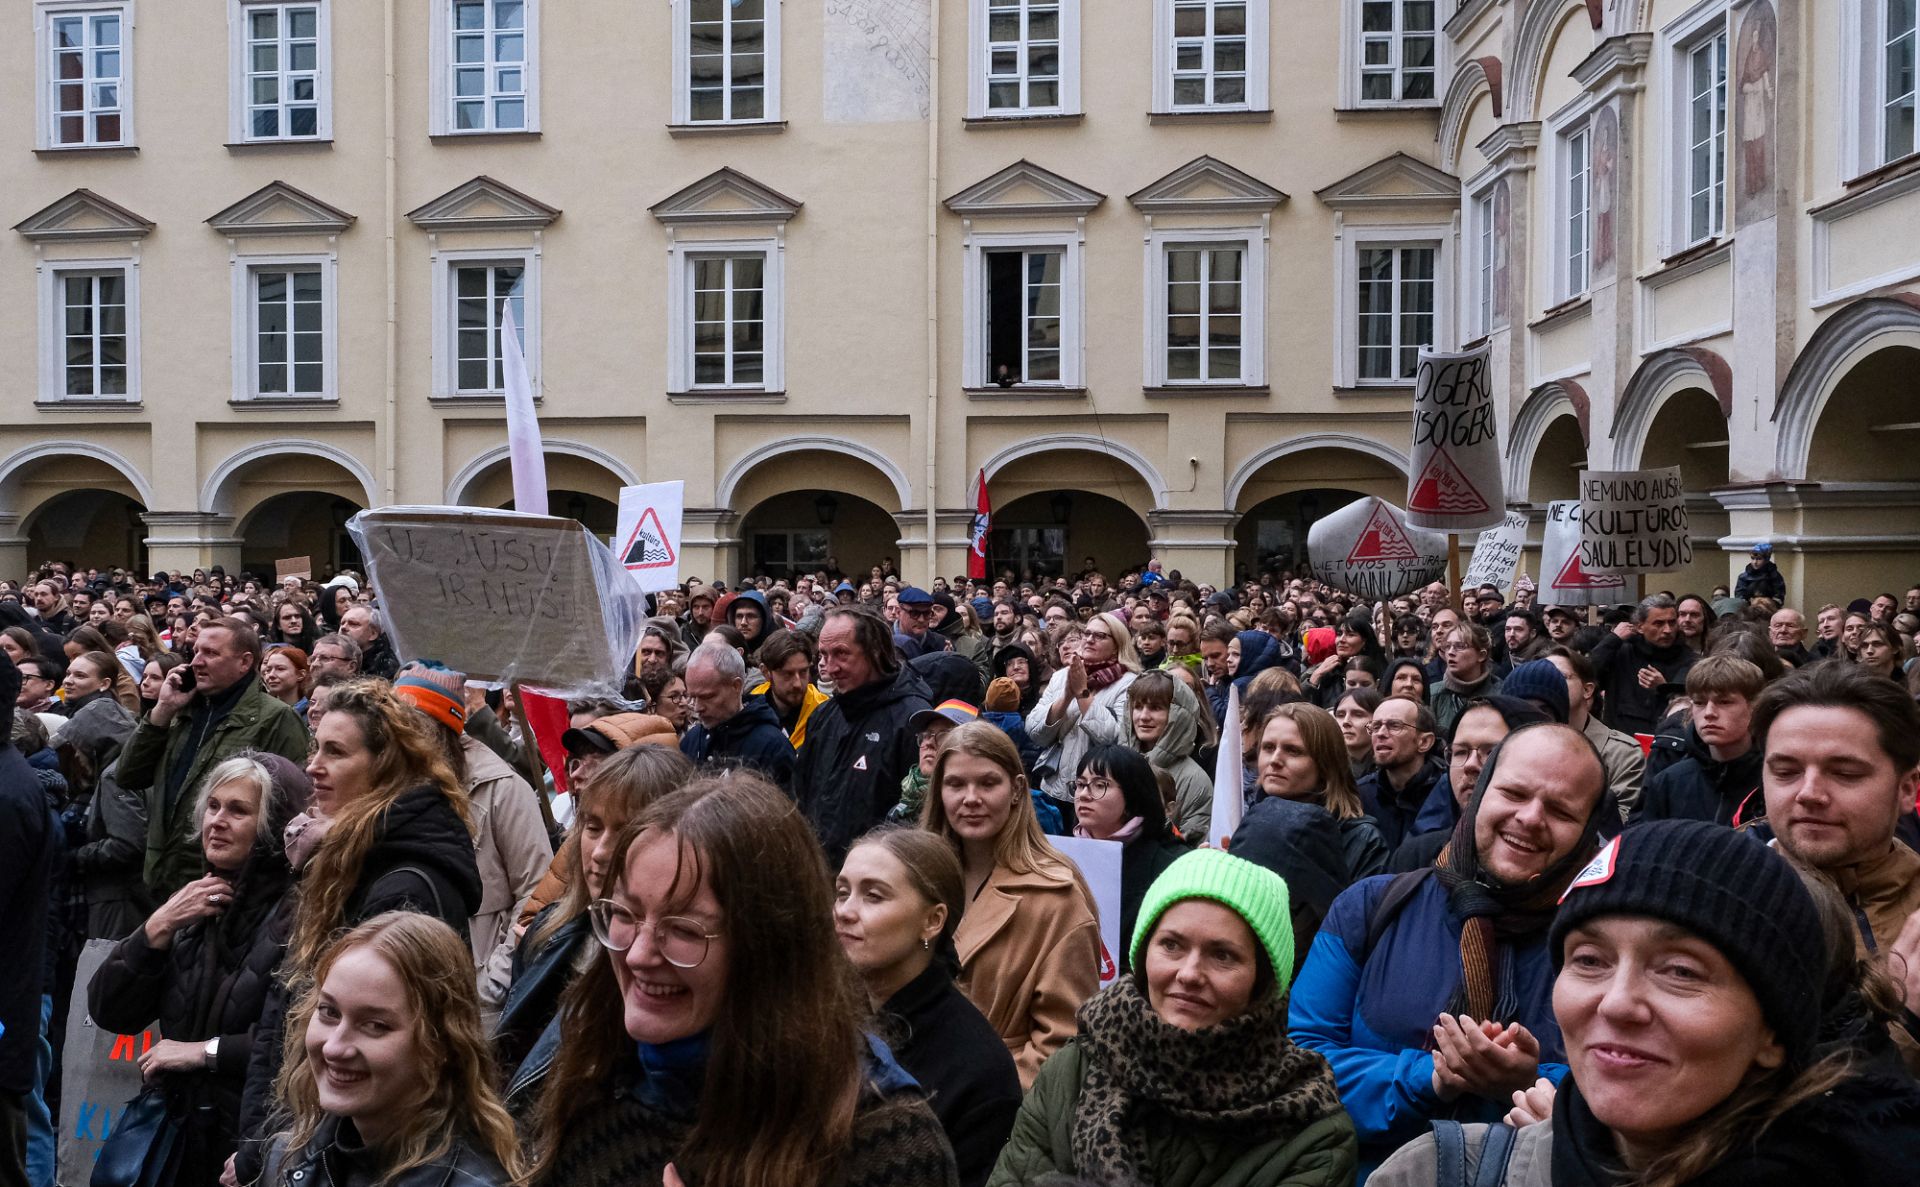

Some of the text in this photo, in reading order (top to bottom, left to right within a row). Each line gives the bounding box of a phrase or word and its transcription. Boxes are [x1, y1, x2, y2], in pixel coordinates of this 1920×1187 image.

[1416, 353, 1492, 406] OGERO
[1583, 480, 1647, 502] NEMUNO
[1547, 503, 1566, 522] NE
[1582, 504, 1689, 536] KULTŪROS
[638, 528, 661, 547] kultūra
[1581, 534, 1692, 568] SAULĖLYDIS
[1313, 558, 1386, 570] LIETUVOS
